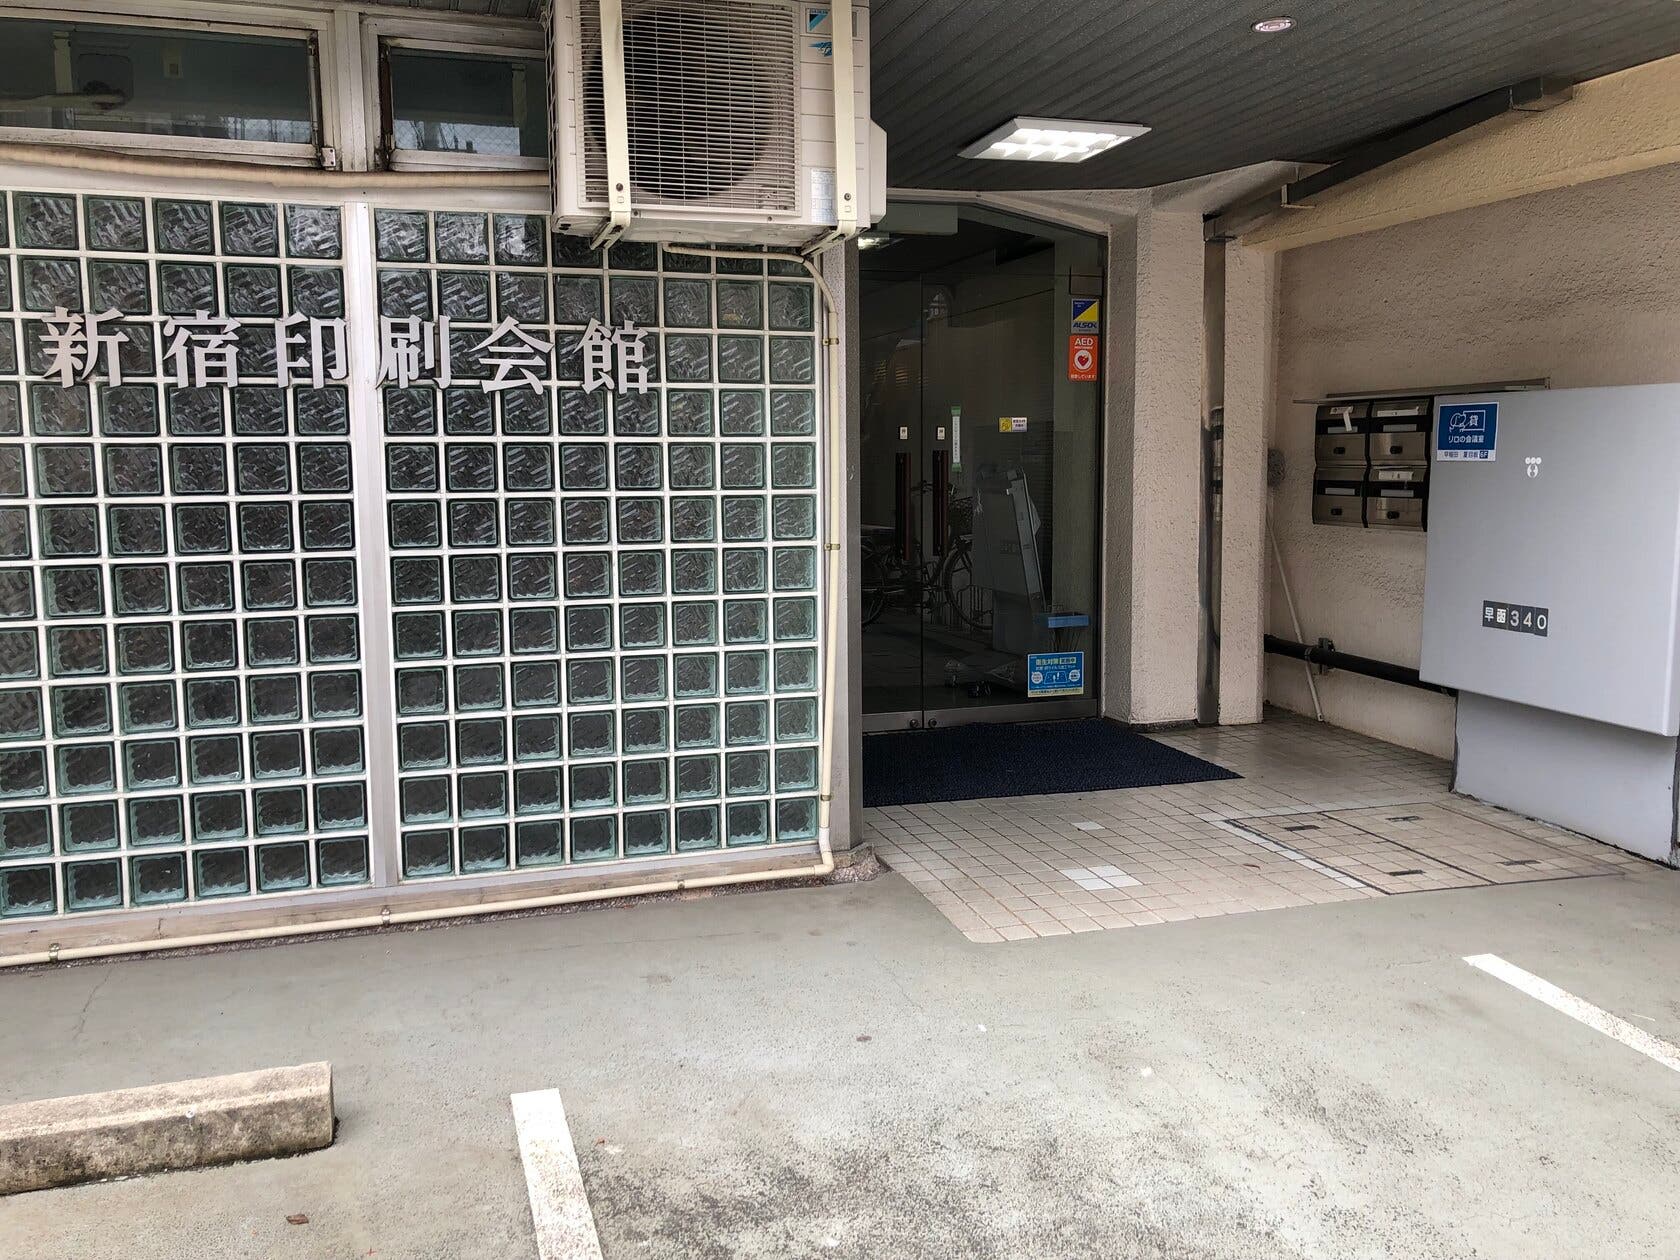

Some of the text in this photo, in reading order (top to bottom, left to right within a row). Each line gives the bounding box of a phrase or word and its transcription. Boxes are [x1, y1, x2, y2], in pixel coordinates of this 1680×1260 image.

[1074, 338, 1094, 346] AED
[38, 306, 650, 395] 新宿印刷会館
[1448, 434, 1485, 444] リロの会議室
